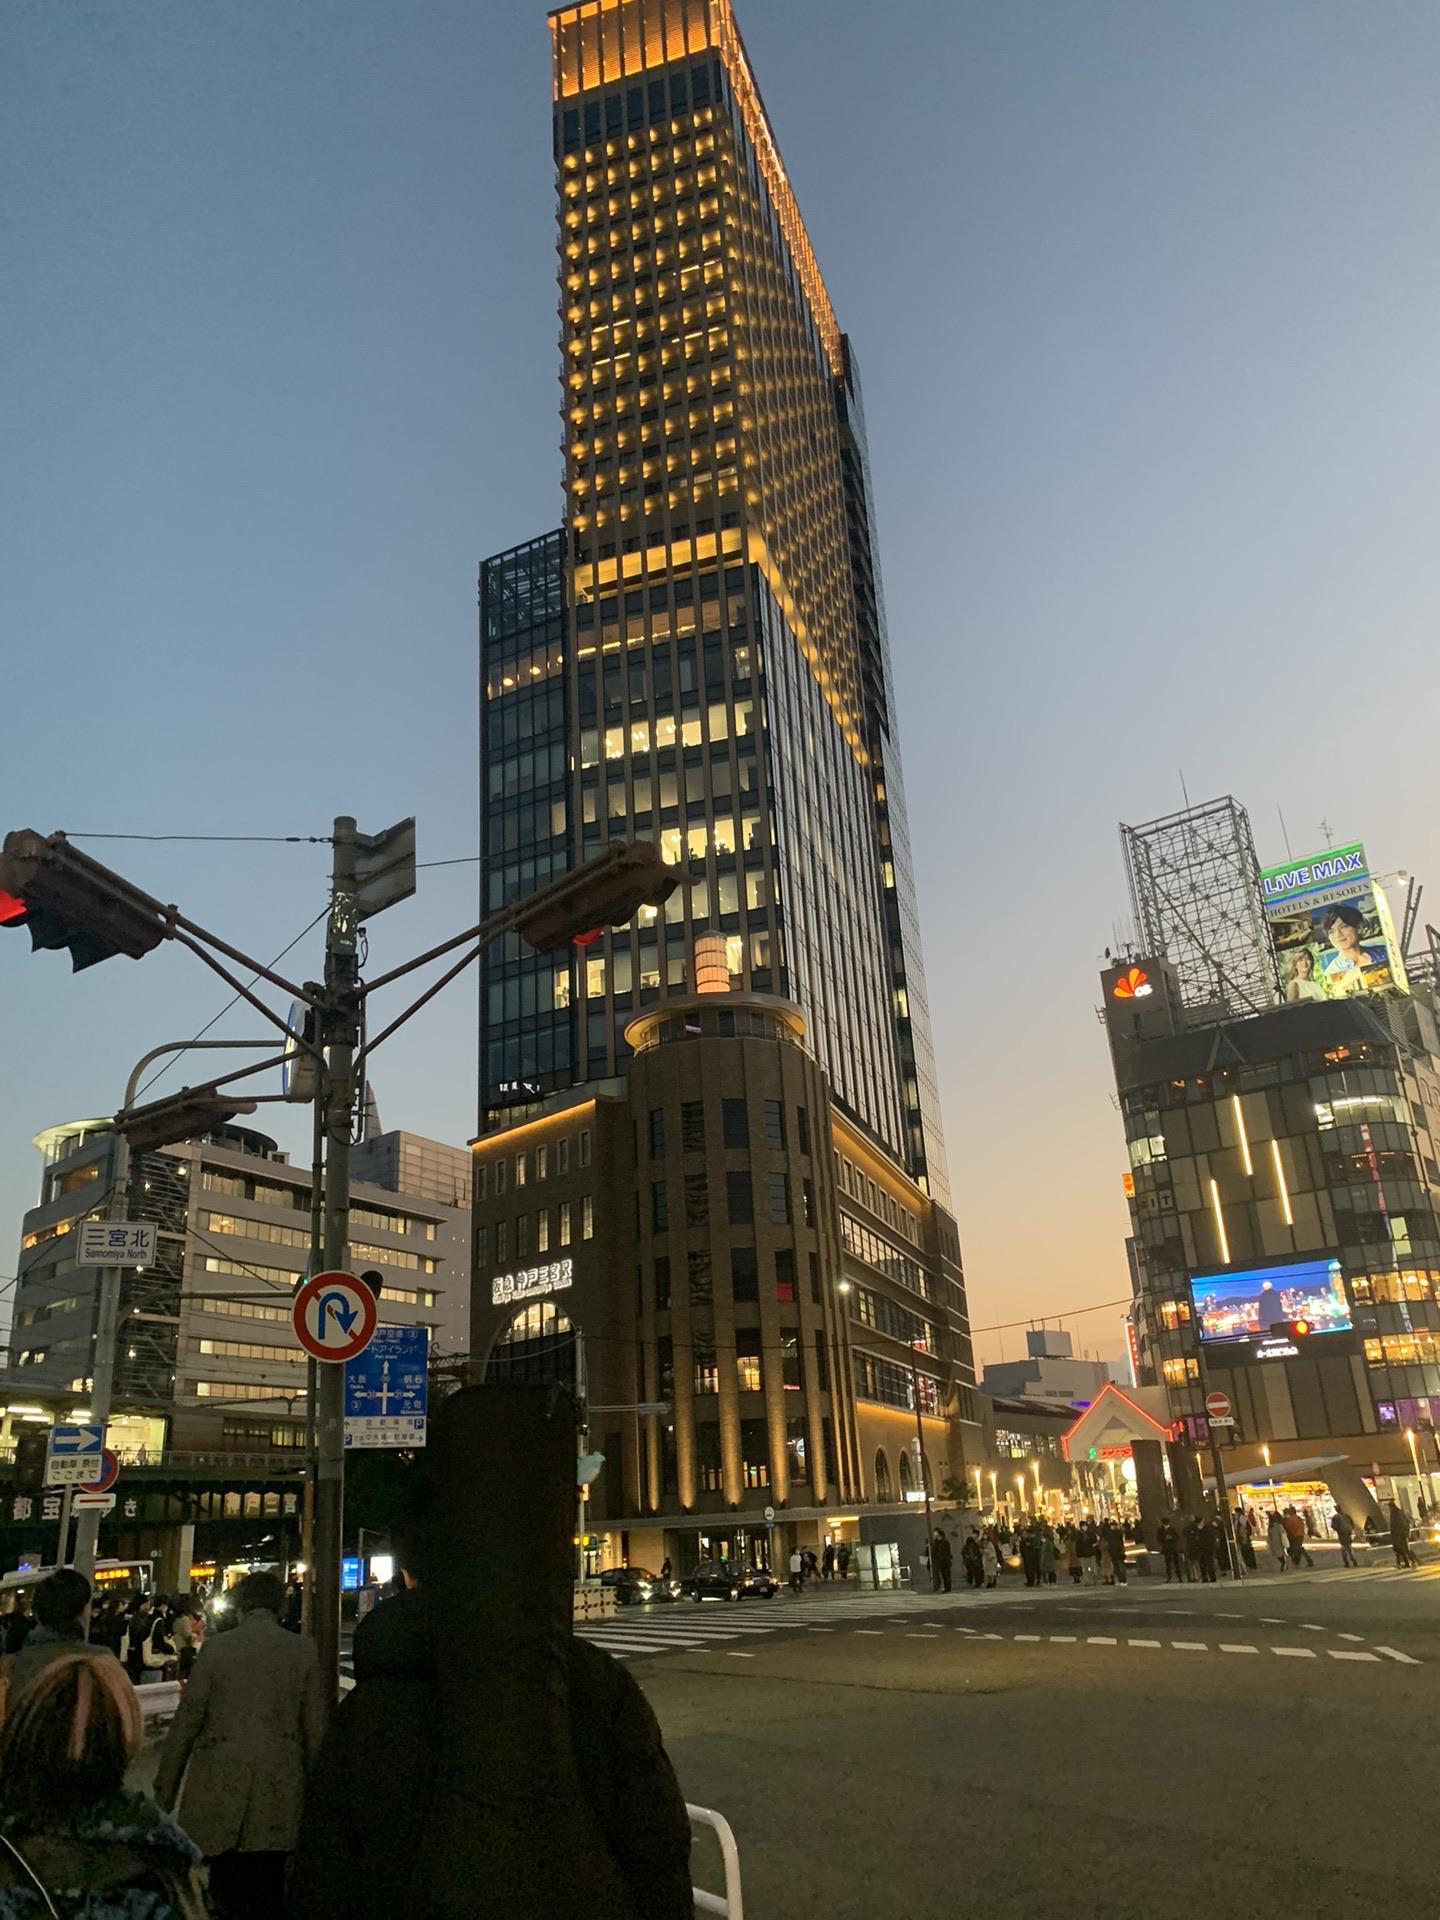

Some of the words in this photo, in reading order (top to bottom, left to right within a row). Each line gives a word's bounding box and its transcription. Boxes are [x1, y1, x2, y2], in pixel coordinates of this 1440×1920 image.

[1312, 851, 1363, 881] MAX
[1269, 899, 1310, 918] HOTELS
[1312, 897, 1320, 906] &
[1323, 883, 1370, 903] RESORTS
[85, 1229, 150, 1247] 三宮北
[85, 1248, 125, 1260] Sannomiya
[127, 1249, 148, 1259] North
[52, 1469, 98, 1480] ここまで
